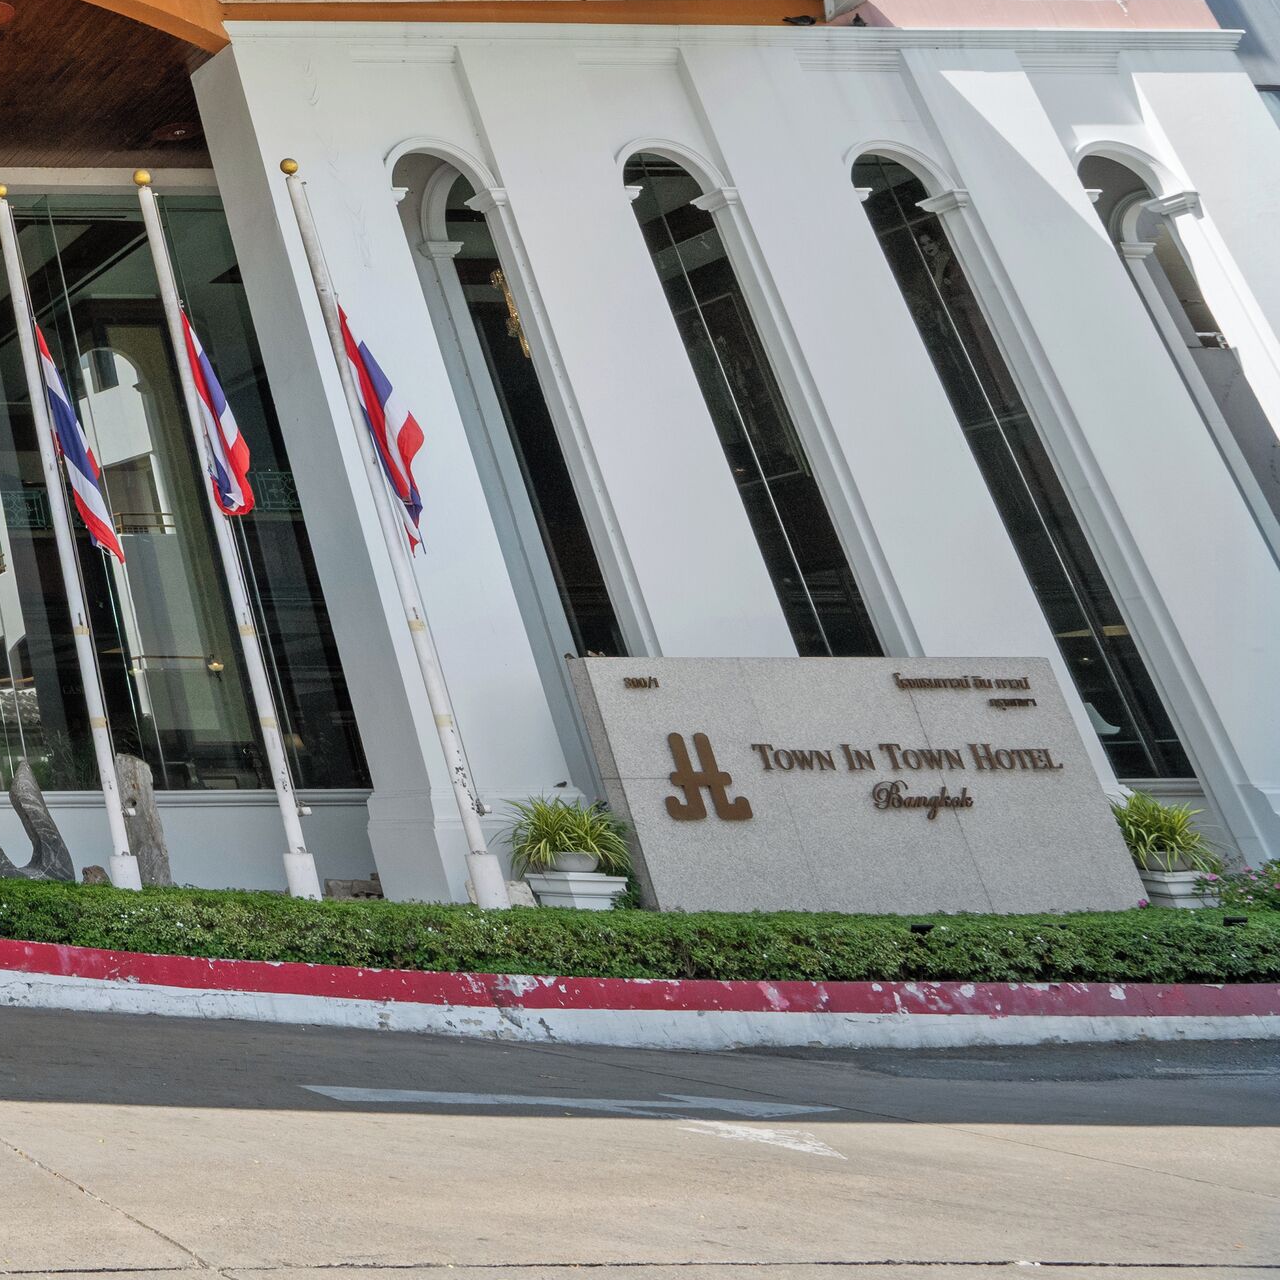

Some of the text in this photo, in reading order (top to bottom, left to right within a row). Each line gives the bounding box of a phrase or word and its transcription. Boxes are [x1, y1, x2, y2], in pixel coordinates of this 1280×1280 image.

[751, 743, 1064, 771] TOWN IN TOWN HOTEL
[872, 780, 974, 820] Bangkok
